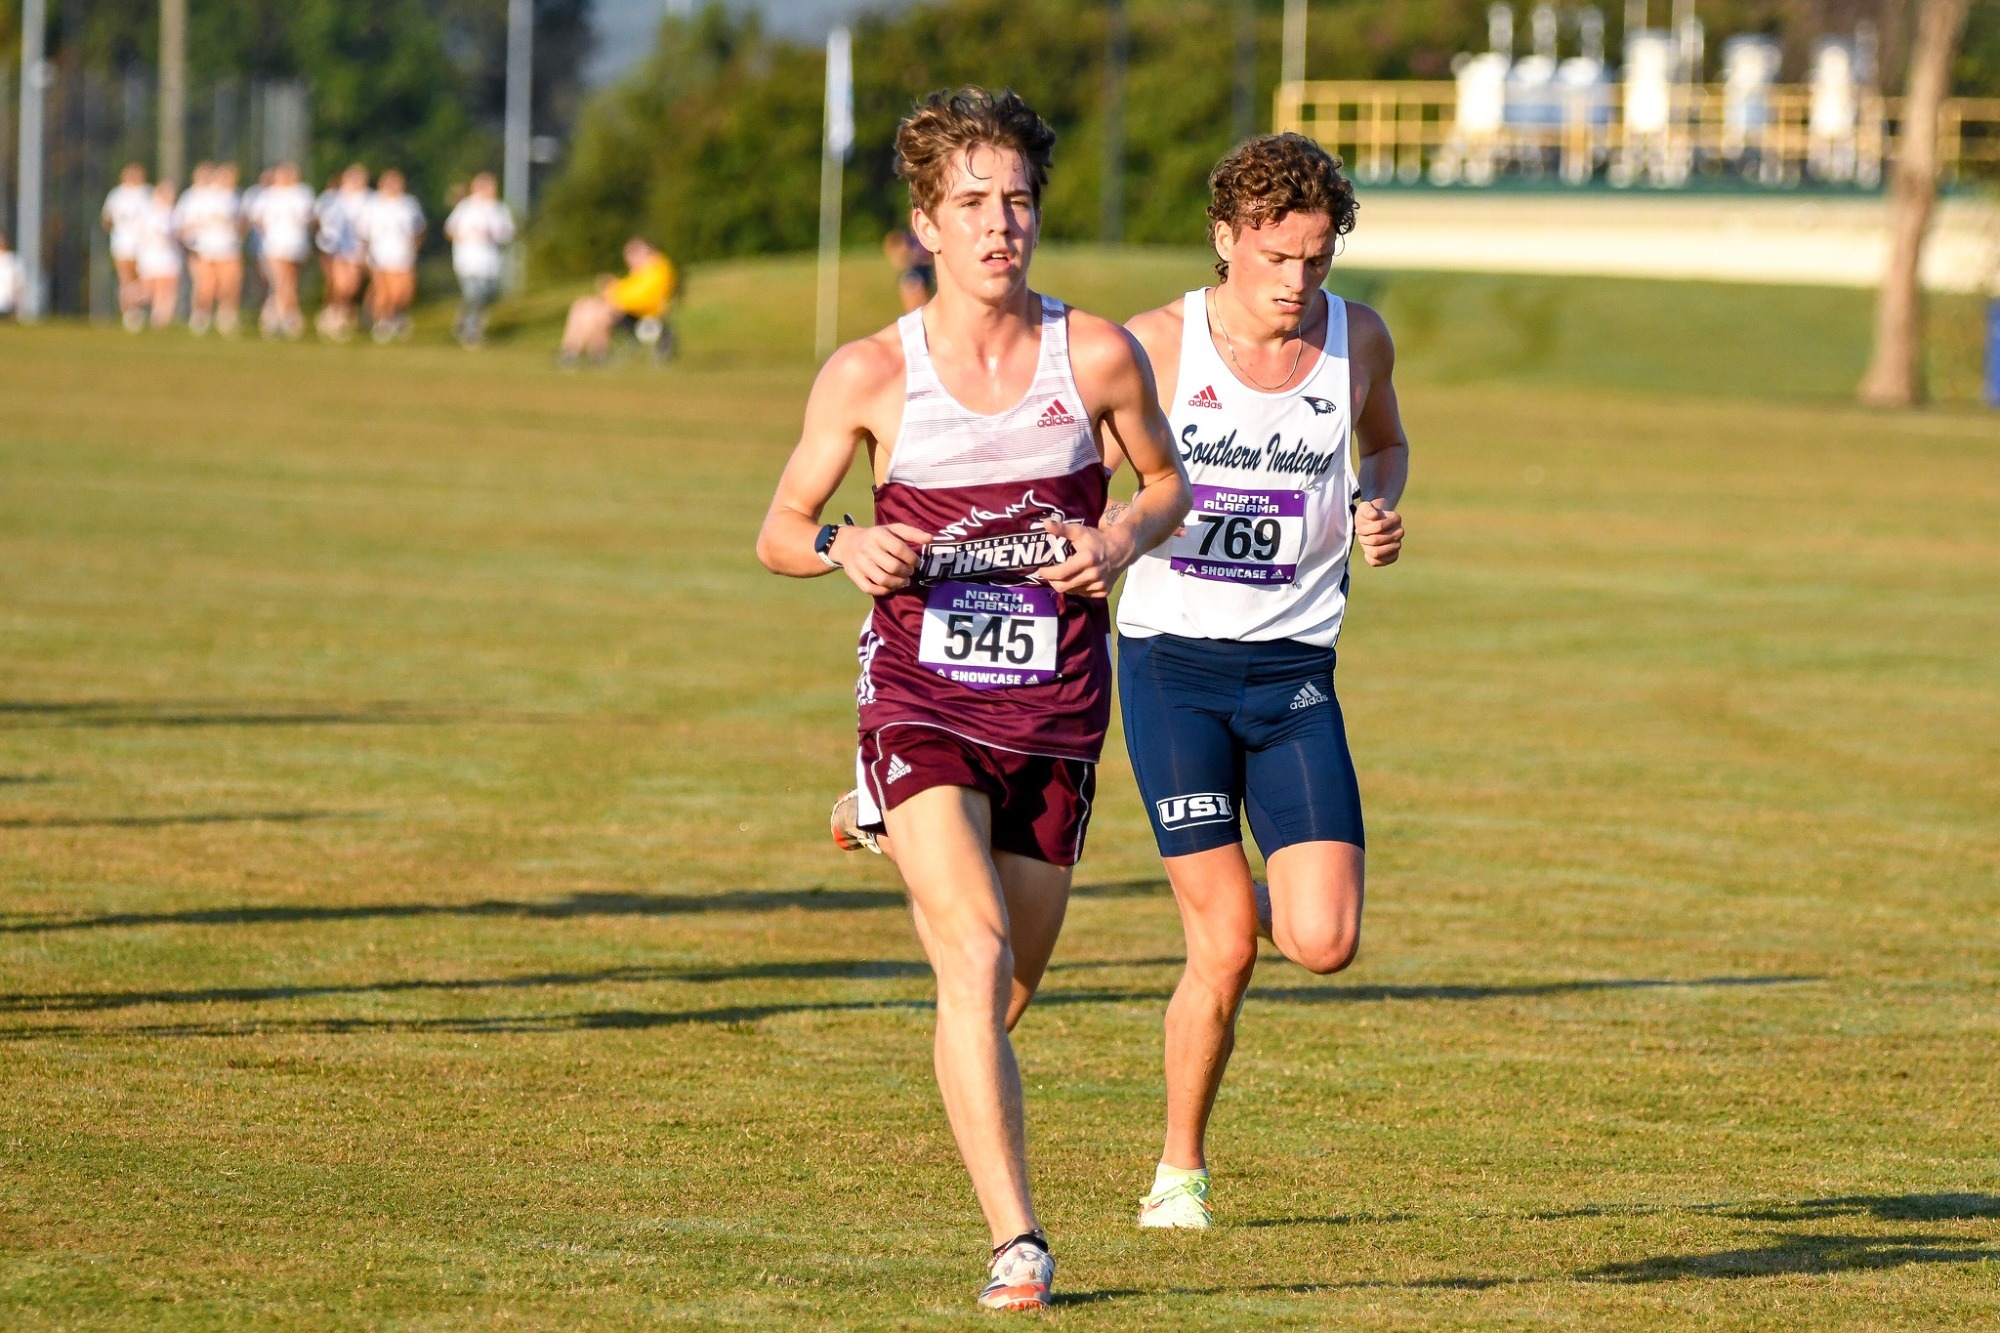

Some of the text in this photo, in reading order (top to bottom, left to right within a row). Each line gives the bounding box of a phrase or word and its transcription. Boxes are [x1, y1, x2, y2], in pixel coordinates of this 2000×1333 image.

[1188, 399, 1223, 410] adidas
[1037, 413, 1075, 428] adidas
[1181, 424, 1334, 476] Southern Indiana
[1215, 491, 1270, 504] NORTH
[1203, 501, 1279, 514] ALABAMA
[956, 533, 1047, 552] CUMBERLAND
[1197, 514, 1281, 561] 769
[928, 533, 1067, 577] PHOENIX
[1200, 567, 1267, 580] SHOWCASE
[965, 589, 1024, 603] NORTH
[952, 599, 1034, 613] ALABAMA
[943, 613, 1036, 665] 545
[950, 671, 1022, 686] SHOWCASE
[1289, 694, 1329, 710] adidas
[1159, 796, 1231, 823] USI
